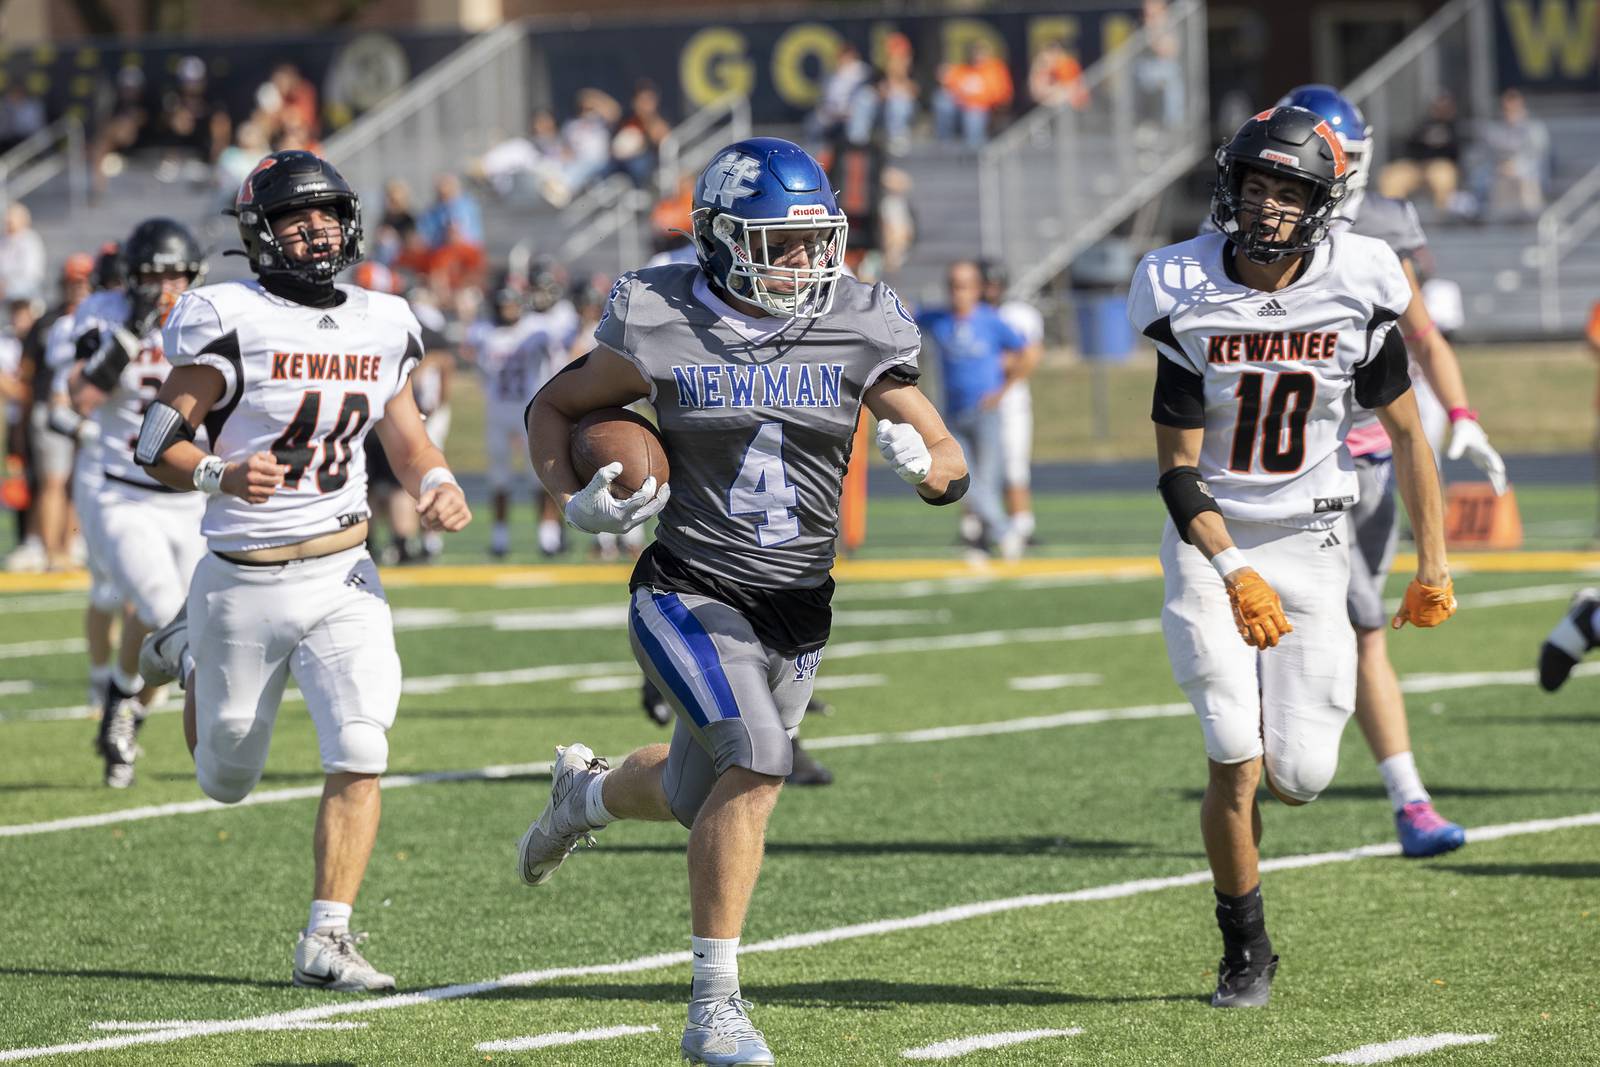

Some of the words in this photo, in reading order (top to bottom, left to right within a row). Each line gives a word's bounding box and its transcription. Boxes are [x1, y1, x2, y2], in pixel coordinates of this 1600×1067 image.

[271, 352, 382, 382] KEWANEE
[1207, 331, 1339, 364] KEWANEE
[671, 363, 845, 408] NEWMAN
[270, 390, 370, 495] 40
[1229, 371, 1316, 475] 10
[728, 420, 801, 548] 4
